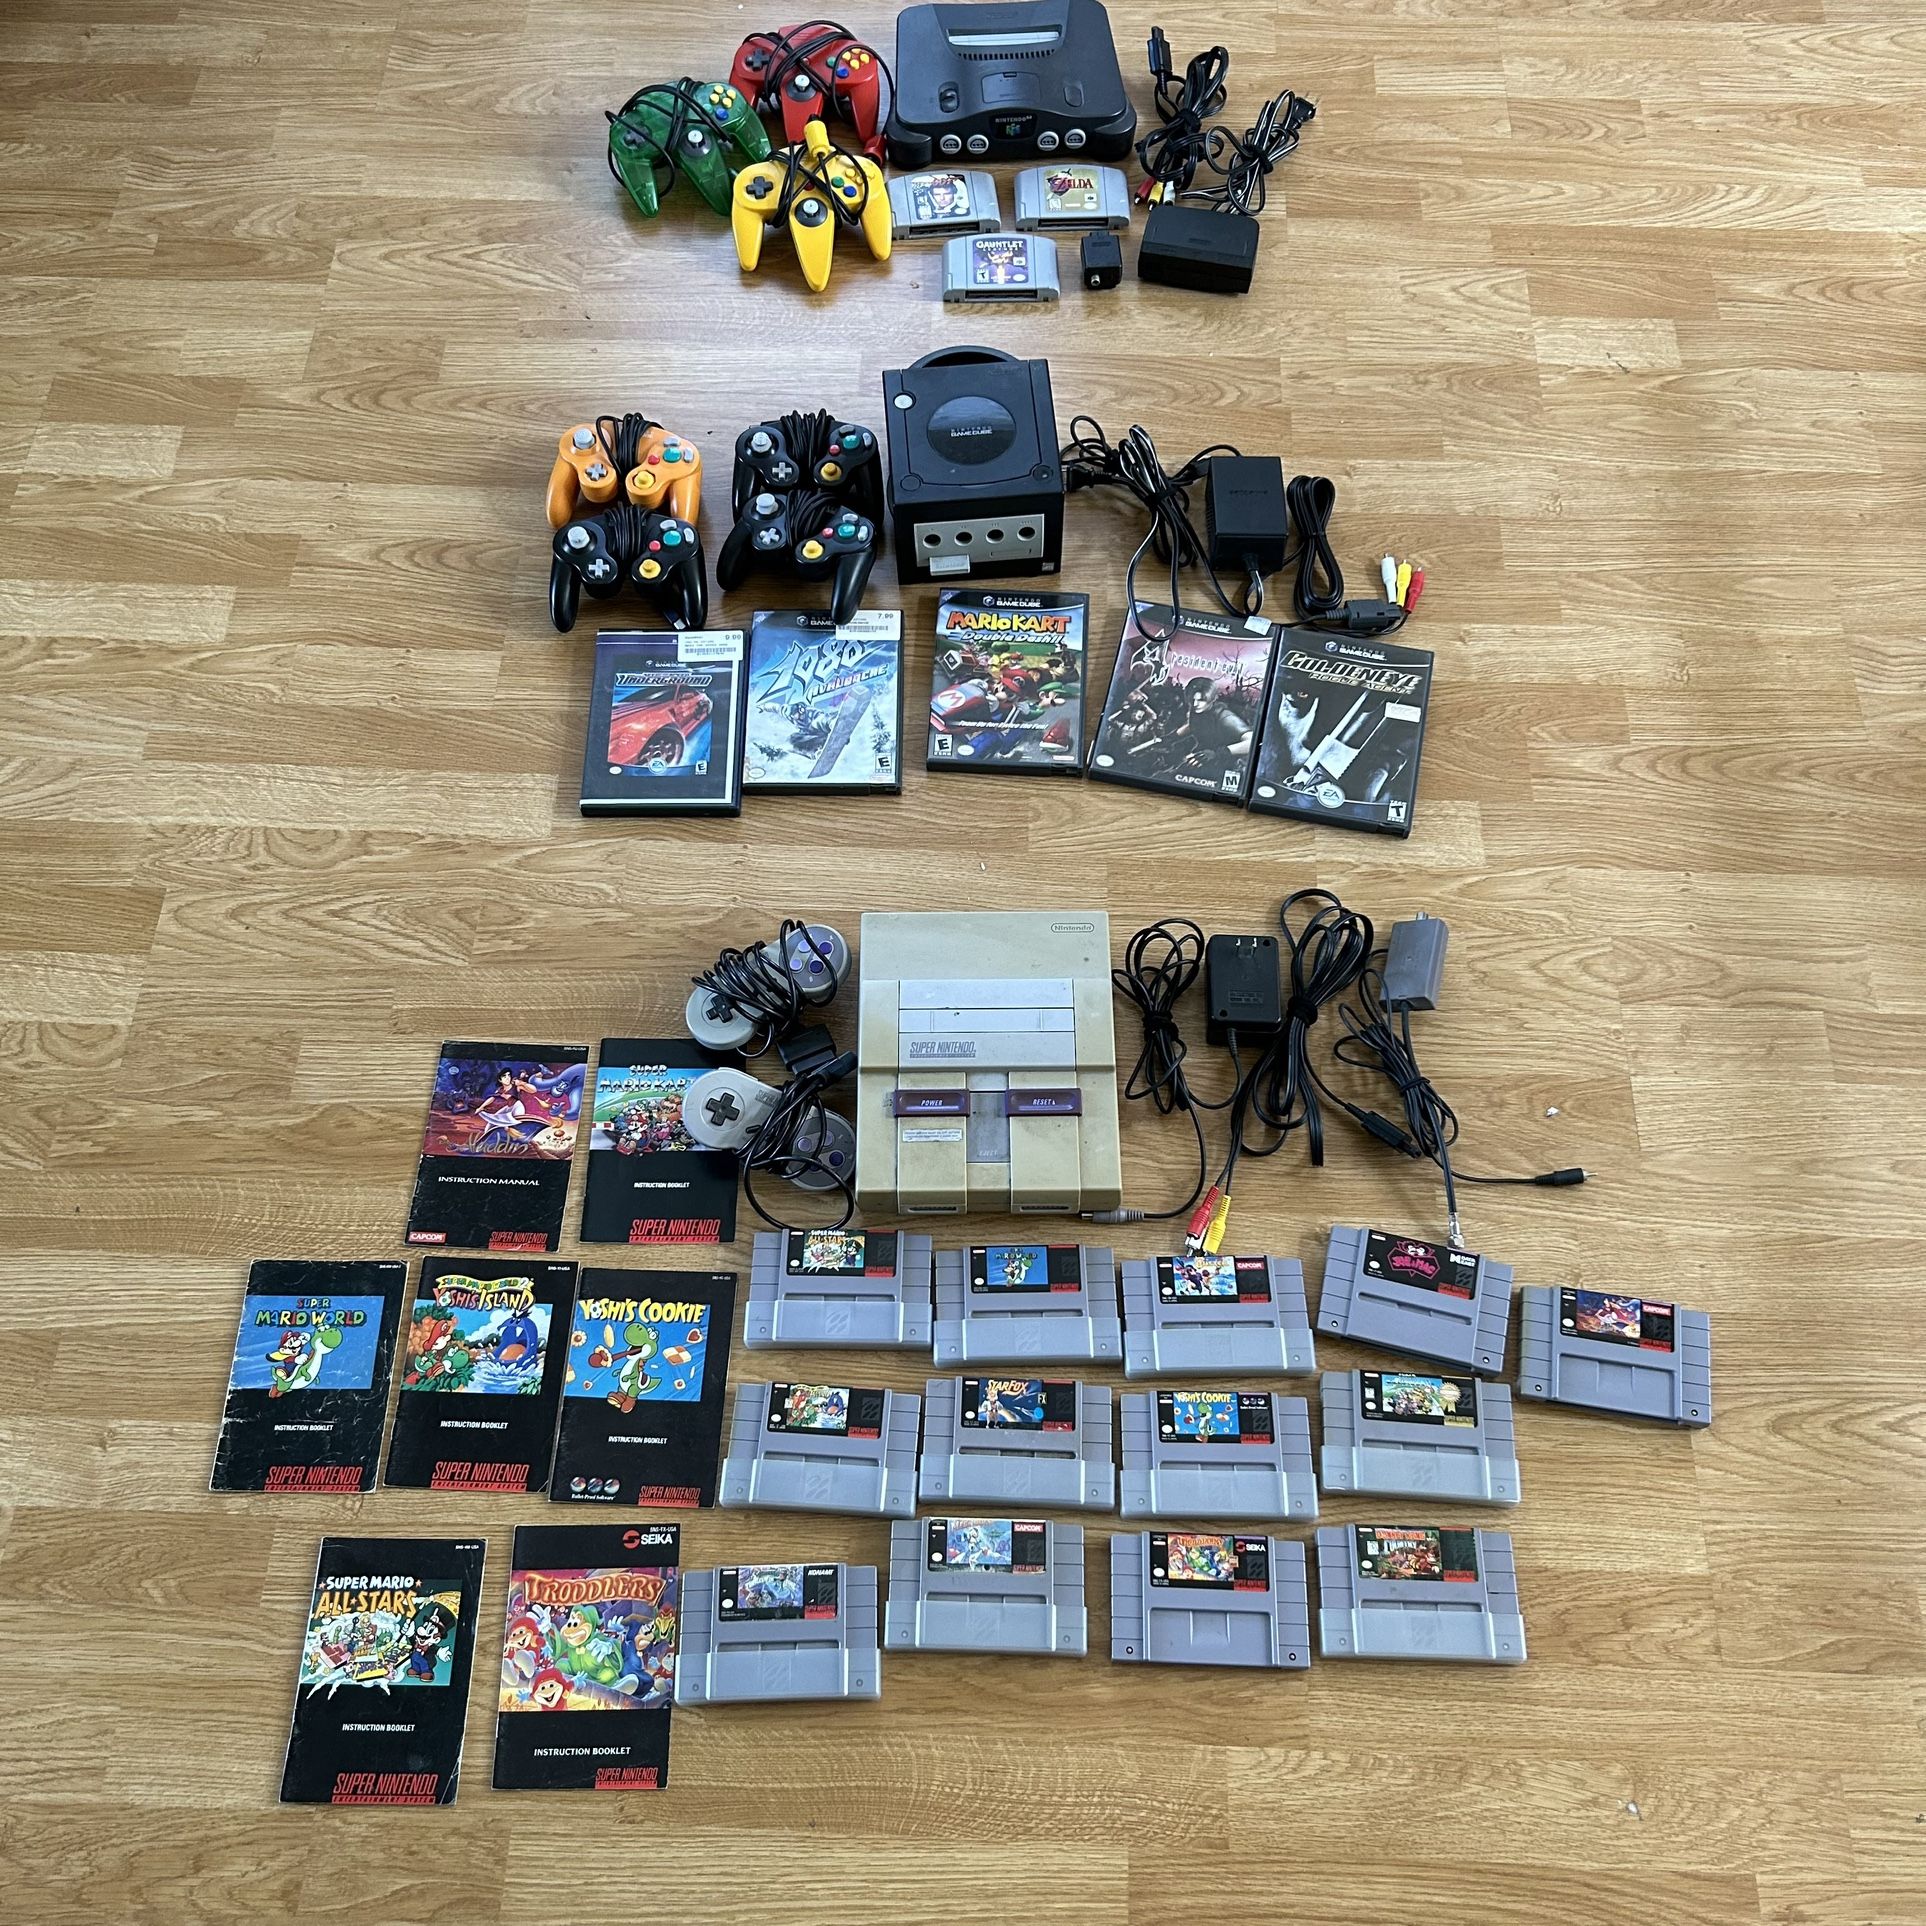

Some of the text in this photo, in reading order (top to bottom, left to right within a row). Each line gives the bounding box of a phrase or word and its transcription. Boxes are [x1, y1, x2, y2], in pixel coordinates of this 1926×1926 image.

[976, 241, 1023, 249] GAUNTLET
[947, 611, 1071, 633] MARIO KART
[962, 632, 1015, 641] Double
[938, 739, 950, 750] E
[1175, 774, 1218, 787] CAPCOM
[1225, 776, 1238, 787] M
[1391, 805, 1404, 817] T
[910, 1041, 975, 1053] SUPER NINTENDO
[629, 1064, 668, 1077] SUPER
[598, 1077, 653, 1093] MARIO
[438, 1176, 540, 1186] INSTRUCTION MANUAL
[630, 1219, 721, 1235] SUPER NINTENDO
[409, 1233, 444, 1242] CAPCOM
[490, 1232, 548, 1243] SUPER NINTENDO
[296, 1298, 331, 1309] SUPER
[478, 1289, 535, 1311] ISLAND
[579, 1298, 706, 1323] YOSHI'S COOKIE
[254, 1310, 367, 1327] MARIO WORLD
[1038, 1394, 1047, 1405] FX
[266, 1466, 363, 1485] SUPER NINTENDO
[433, 1462, 530, 1483] SUPER NINTENDO
[639, 1486, 701, 1500] SUPER NINTENDO
[641, 1533, 673, 1545] SEIKA
[1245, 1543, 1266, 1552] SEIKA
[327, 1576, 415, 1590] SUPER MARIO
[524, 1573, 667, 1606] TRODDLERS
[315, 1590, 418, 1619] ALL STARS
[386, 1724, 415, 1732] BOOKLET
[534, 1747, 631, 1756] INSTRUCTION BOOKLET
[596, 1768, 658, 1781] SUPER NINTENDO
[333, 1773, 438, 1795] SUPER NINTENDO
